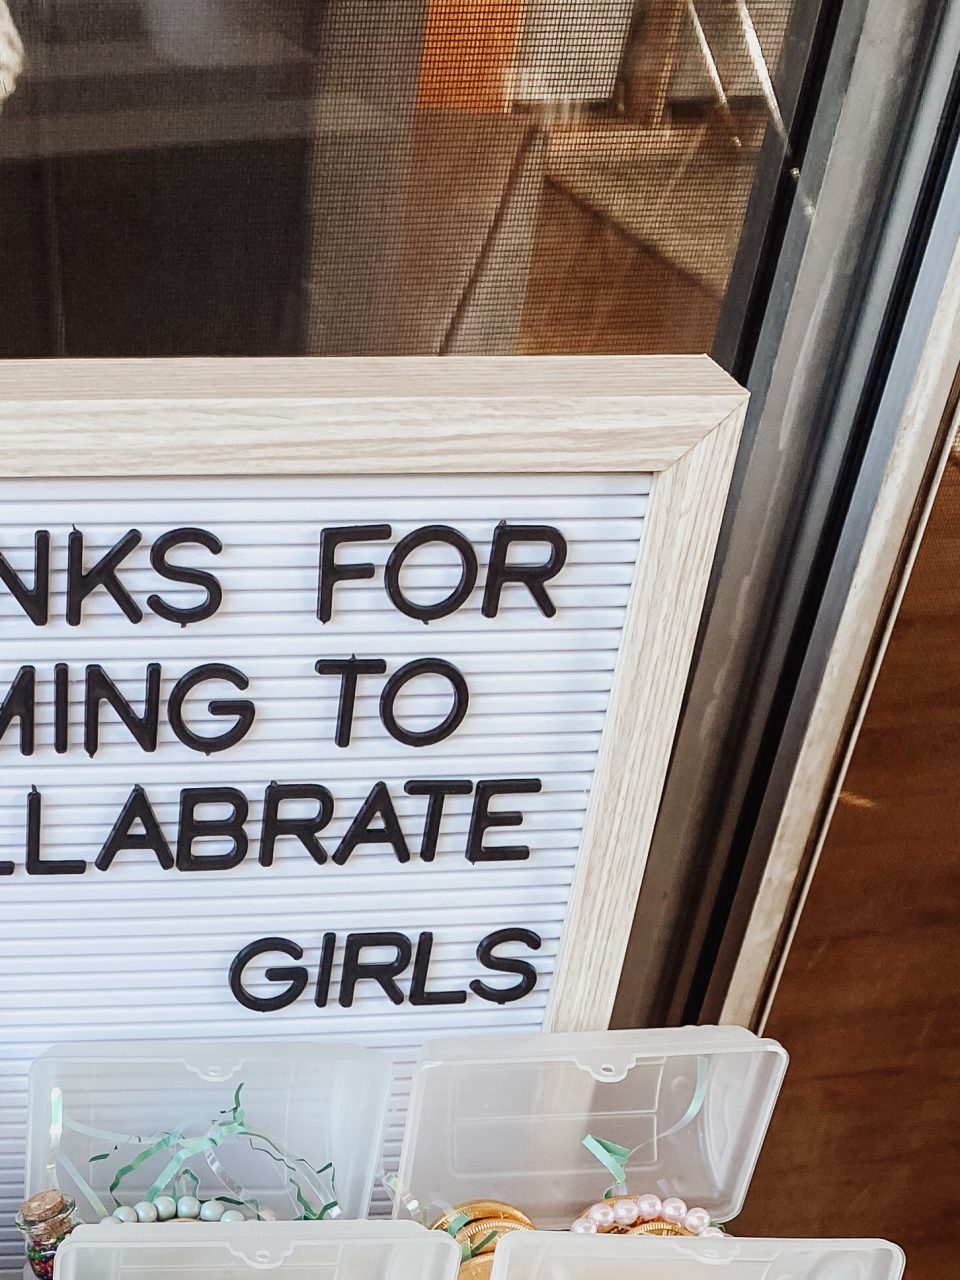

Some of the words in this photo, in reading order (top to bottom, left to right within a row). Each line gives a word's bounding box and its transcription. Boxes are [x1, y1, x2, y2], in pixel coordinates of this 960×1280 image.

[315, 519, 569, 626] FOR
[313, 653, 471, 749] TO
[228, 926, 543, 1014] GIRLS
